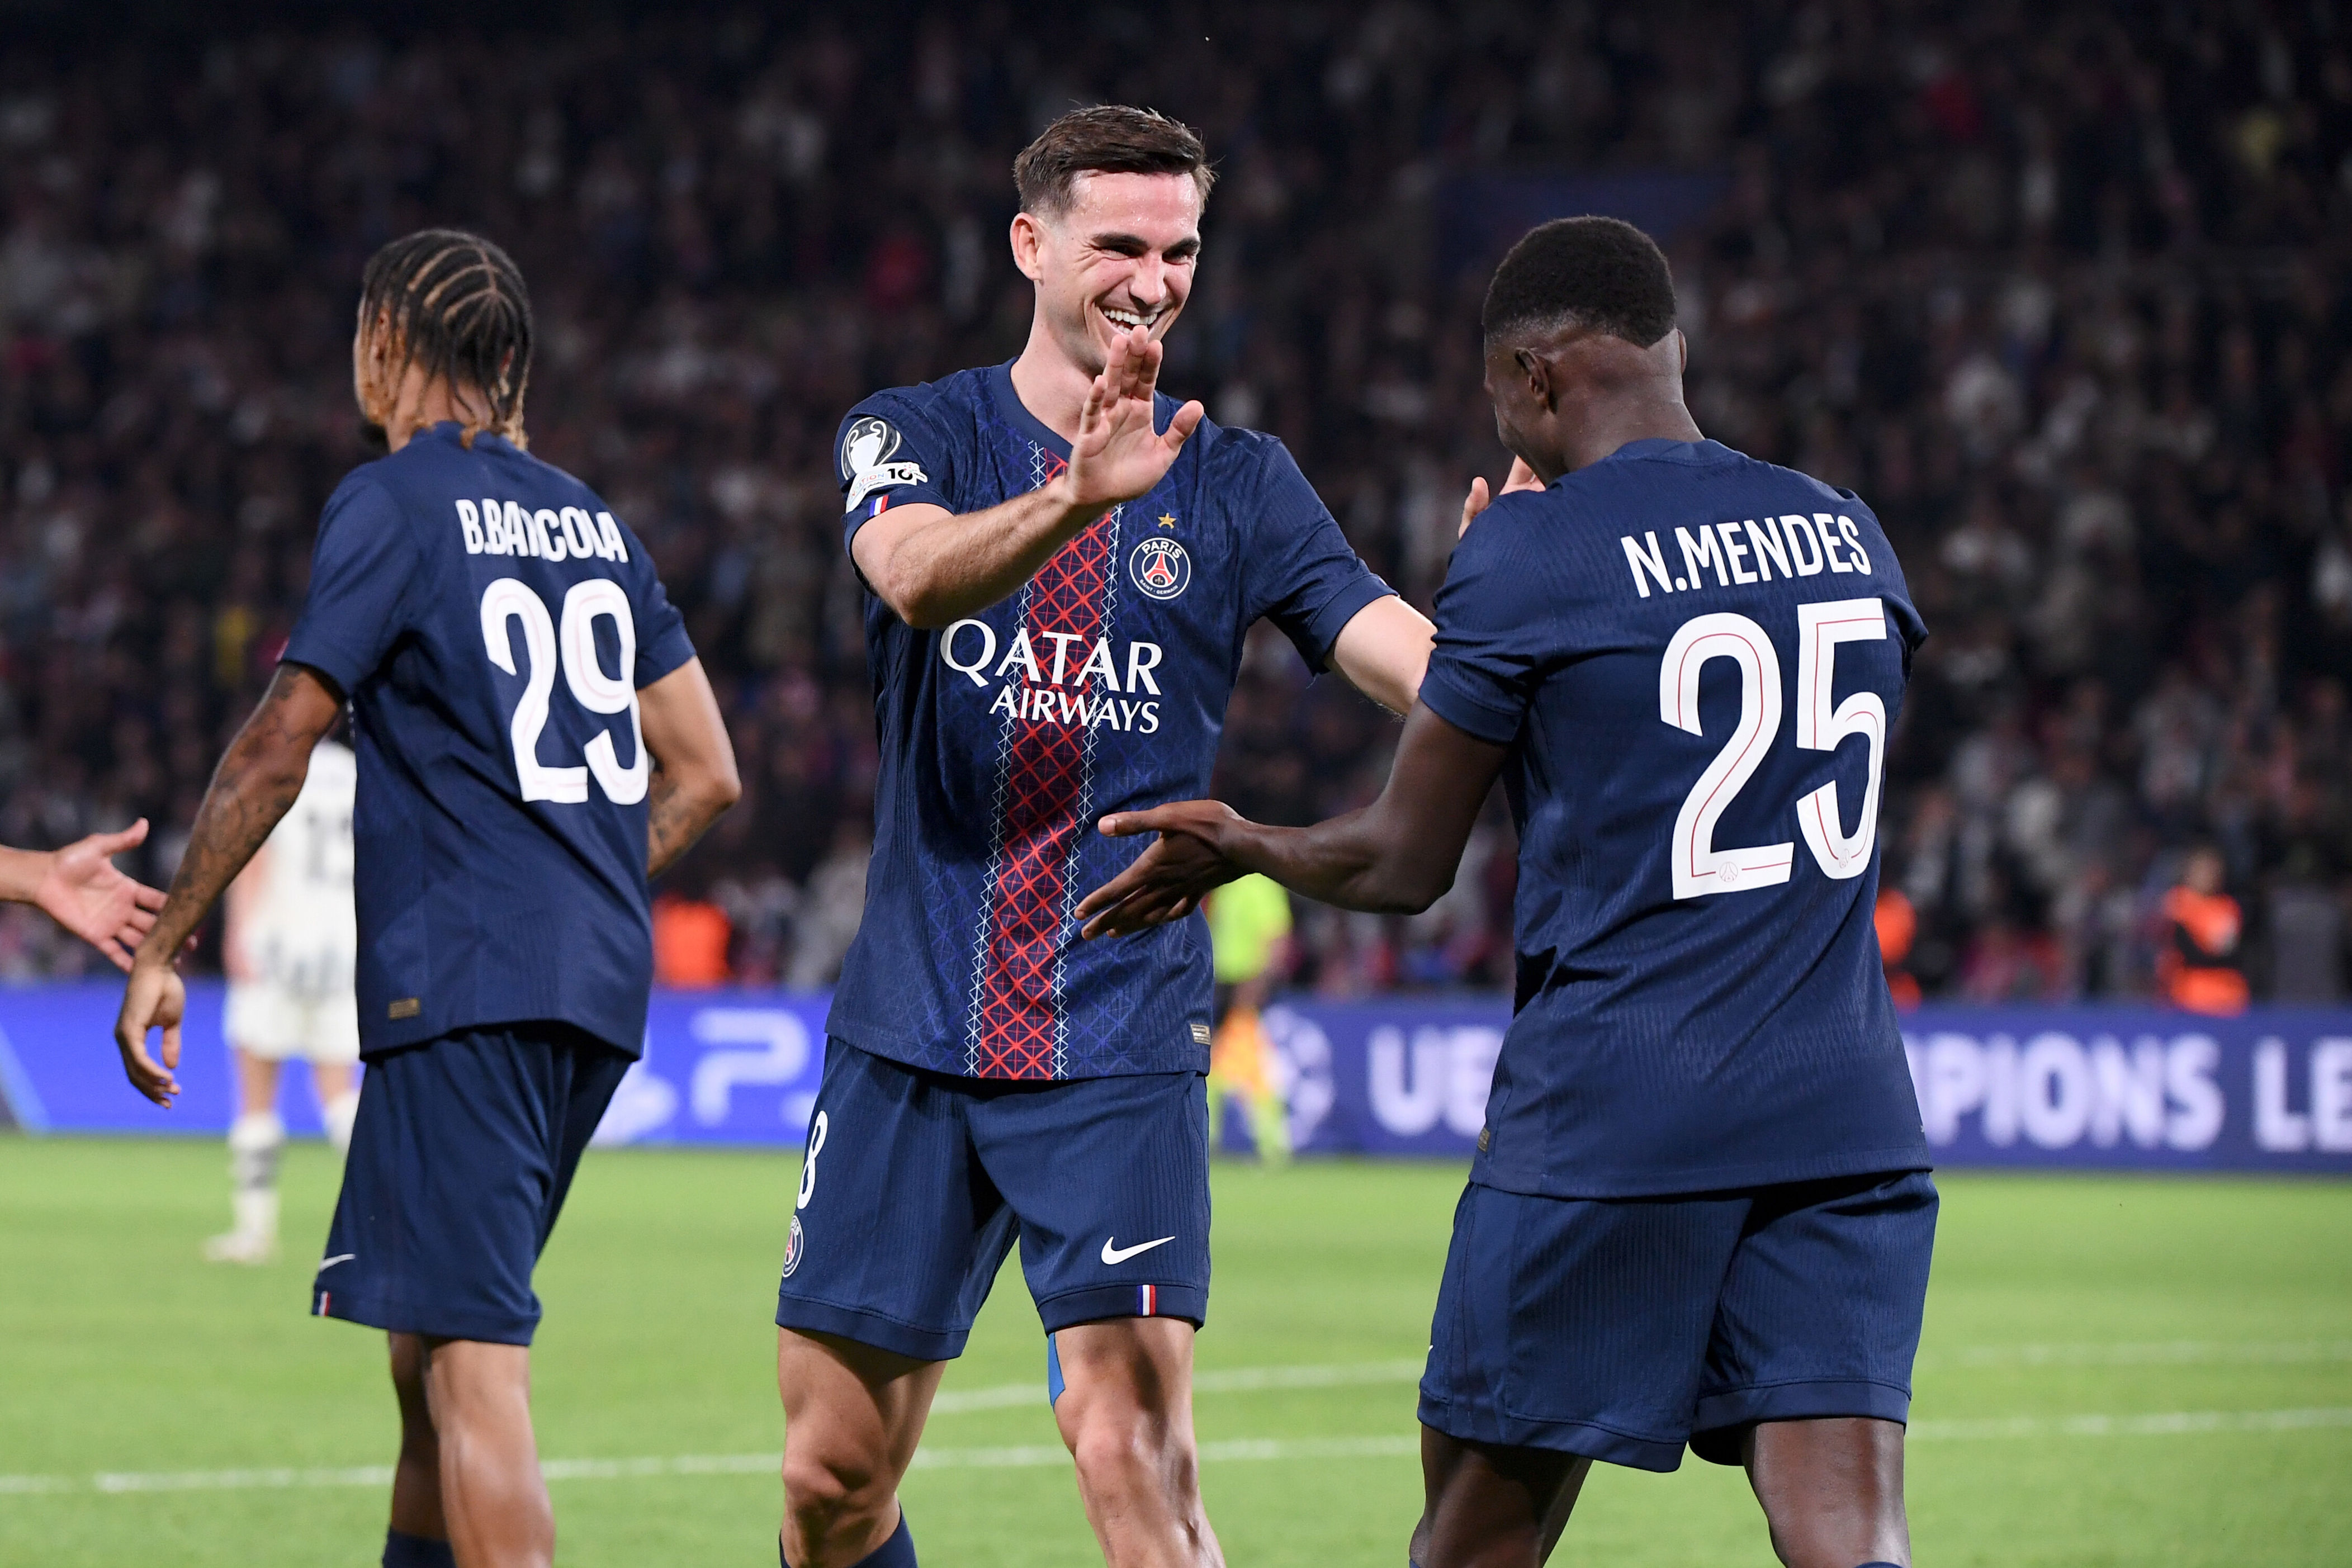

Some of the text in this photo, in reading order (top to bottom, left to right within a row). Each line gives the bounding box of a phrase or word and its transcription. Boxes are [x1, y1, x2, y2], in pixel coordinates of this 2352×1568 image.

[1142, 541, 1182, 559] PARIS
[1620, 513, 1872, 598] N.MENDES
[480, 577, 649, 806] 29
[940, 618, 1163, 695] QATAR
[988, 684, 1161, 734] AIRWAYS
[1659, 598, 1887, 900] 25
[1902, 1032, 2226, 1152] PIONS
[2253, 1036, 2352, 1153] LE
[797, 1110, 828, 1210] 8
